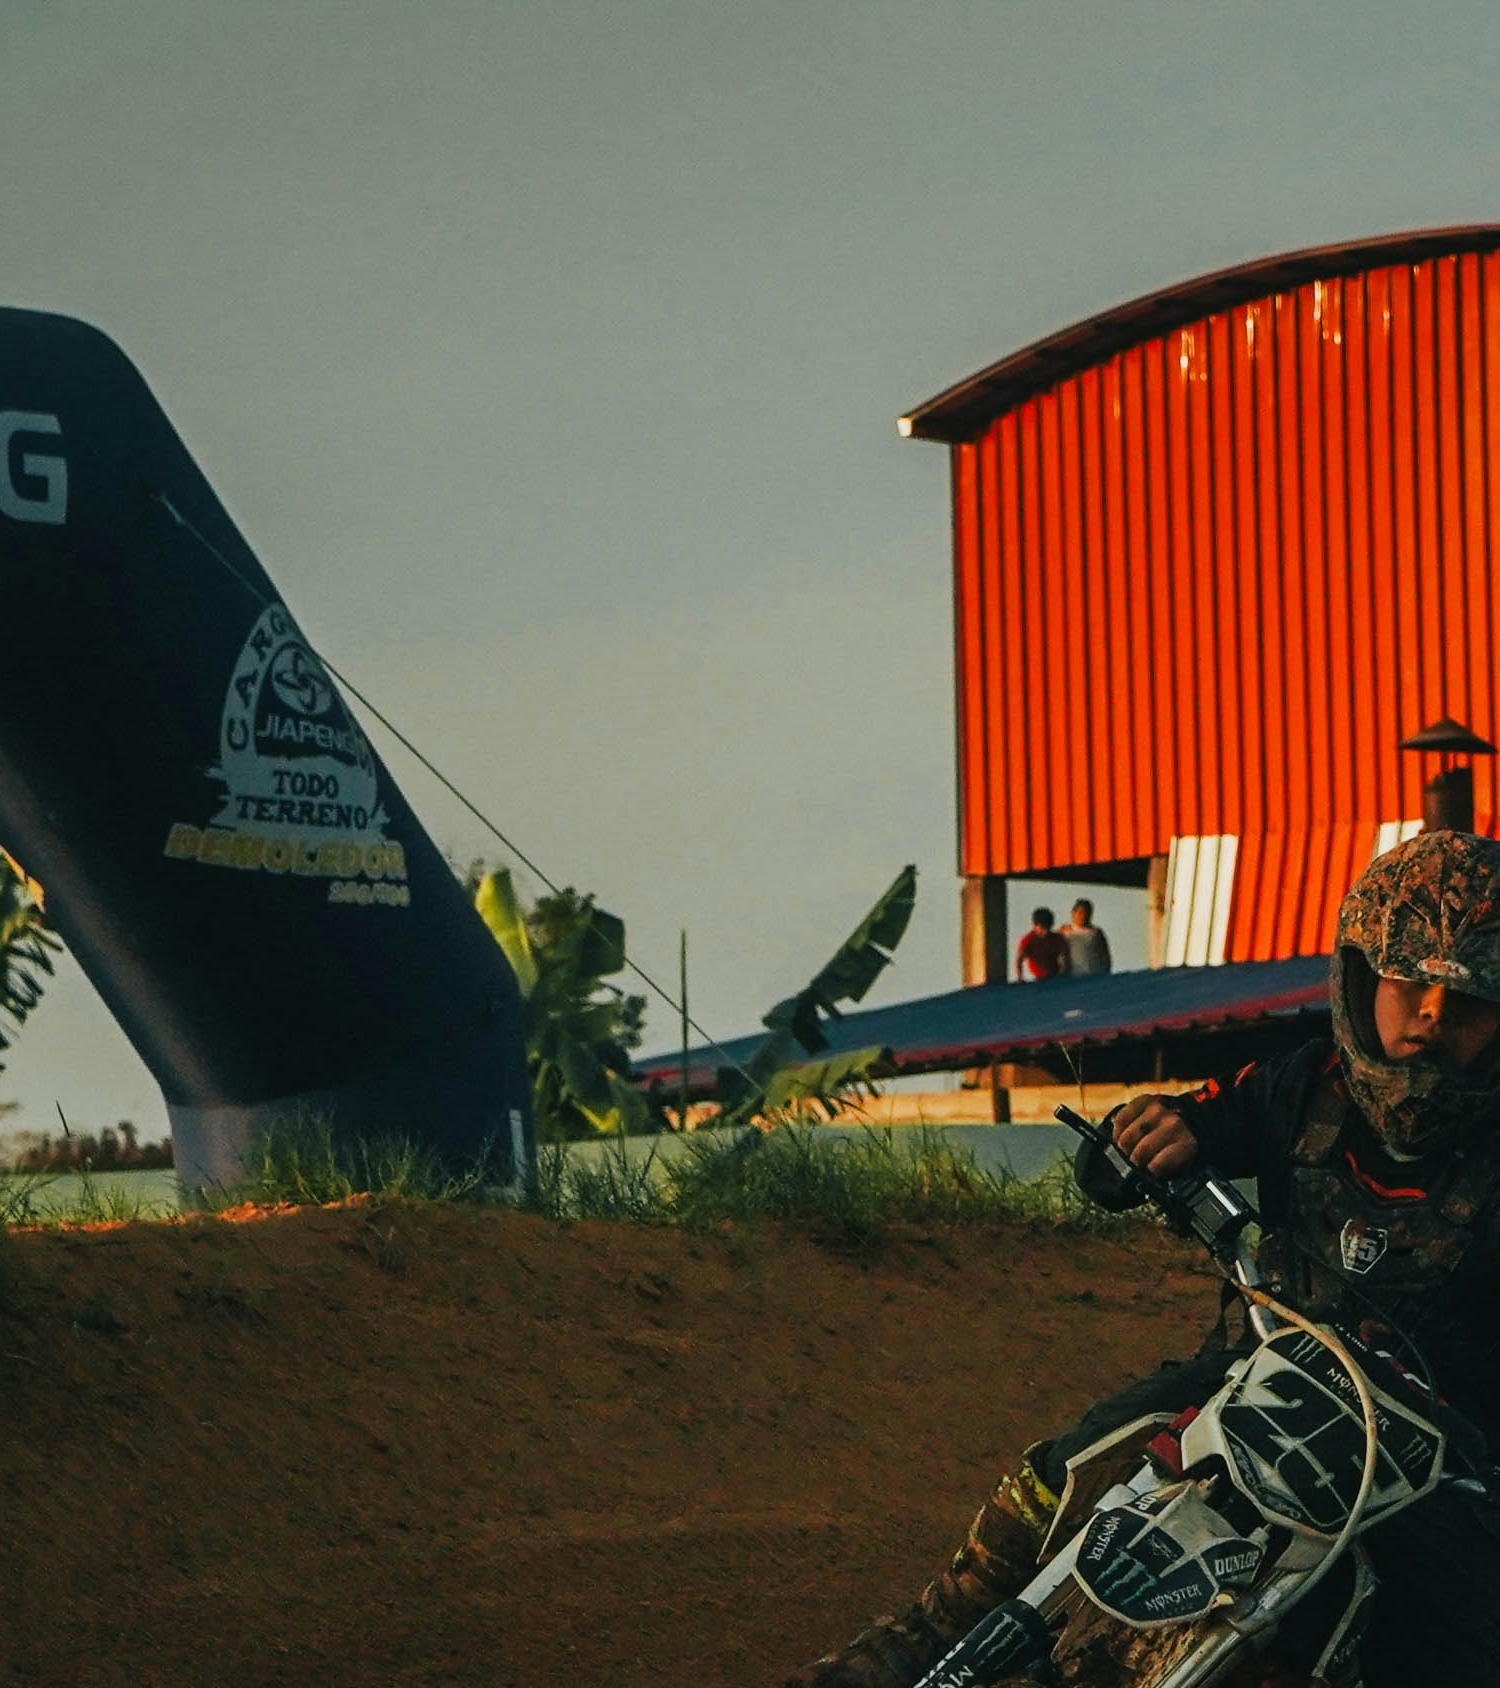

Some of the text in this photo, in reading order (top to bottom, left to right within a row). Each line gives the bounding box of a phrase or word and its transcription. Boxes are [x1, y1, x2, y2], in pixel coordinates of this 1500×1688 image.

[273, 769, 340, 799] TODO
[236, 795, 368, 831] TERRENO
[1214, 1549, 1261, 1577] DUNLOP
[1144, 1583, 1203, 1612] MONSTER
